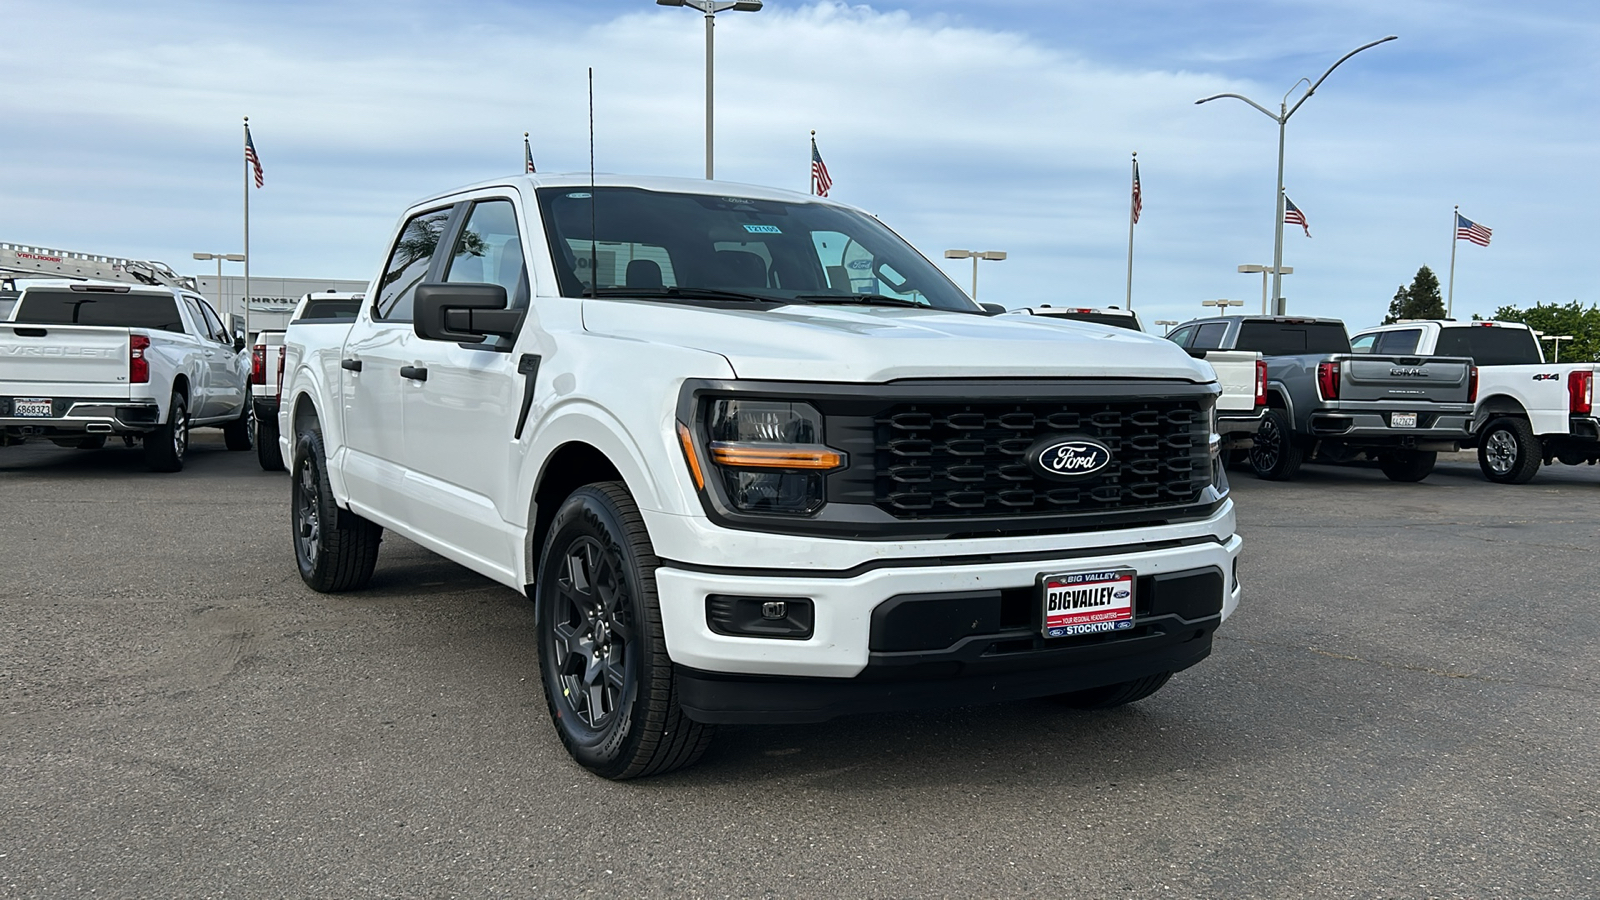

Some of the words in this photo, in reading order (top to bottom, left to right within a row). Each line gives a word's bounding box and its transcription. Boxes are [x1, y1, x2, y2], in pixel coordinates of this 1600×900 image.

[852, 260, 872, 269] Ford
[1389, 368, 1429, 377] GMC
[1053, 445, 1098, 470] Ford
[1067, 575, 1082, 583] BIG
[1084, 572, 1115, 582] VALLEY
[1048, 586, 1115, 612] BIGVALLEY
[1073, 615, 1090, 623] REGIONAL
[1091, 612, 1118, 621] HEADQUARTERS
[1066, 621, 1115, 635] STOCKTON
